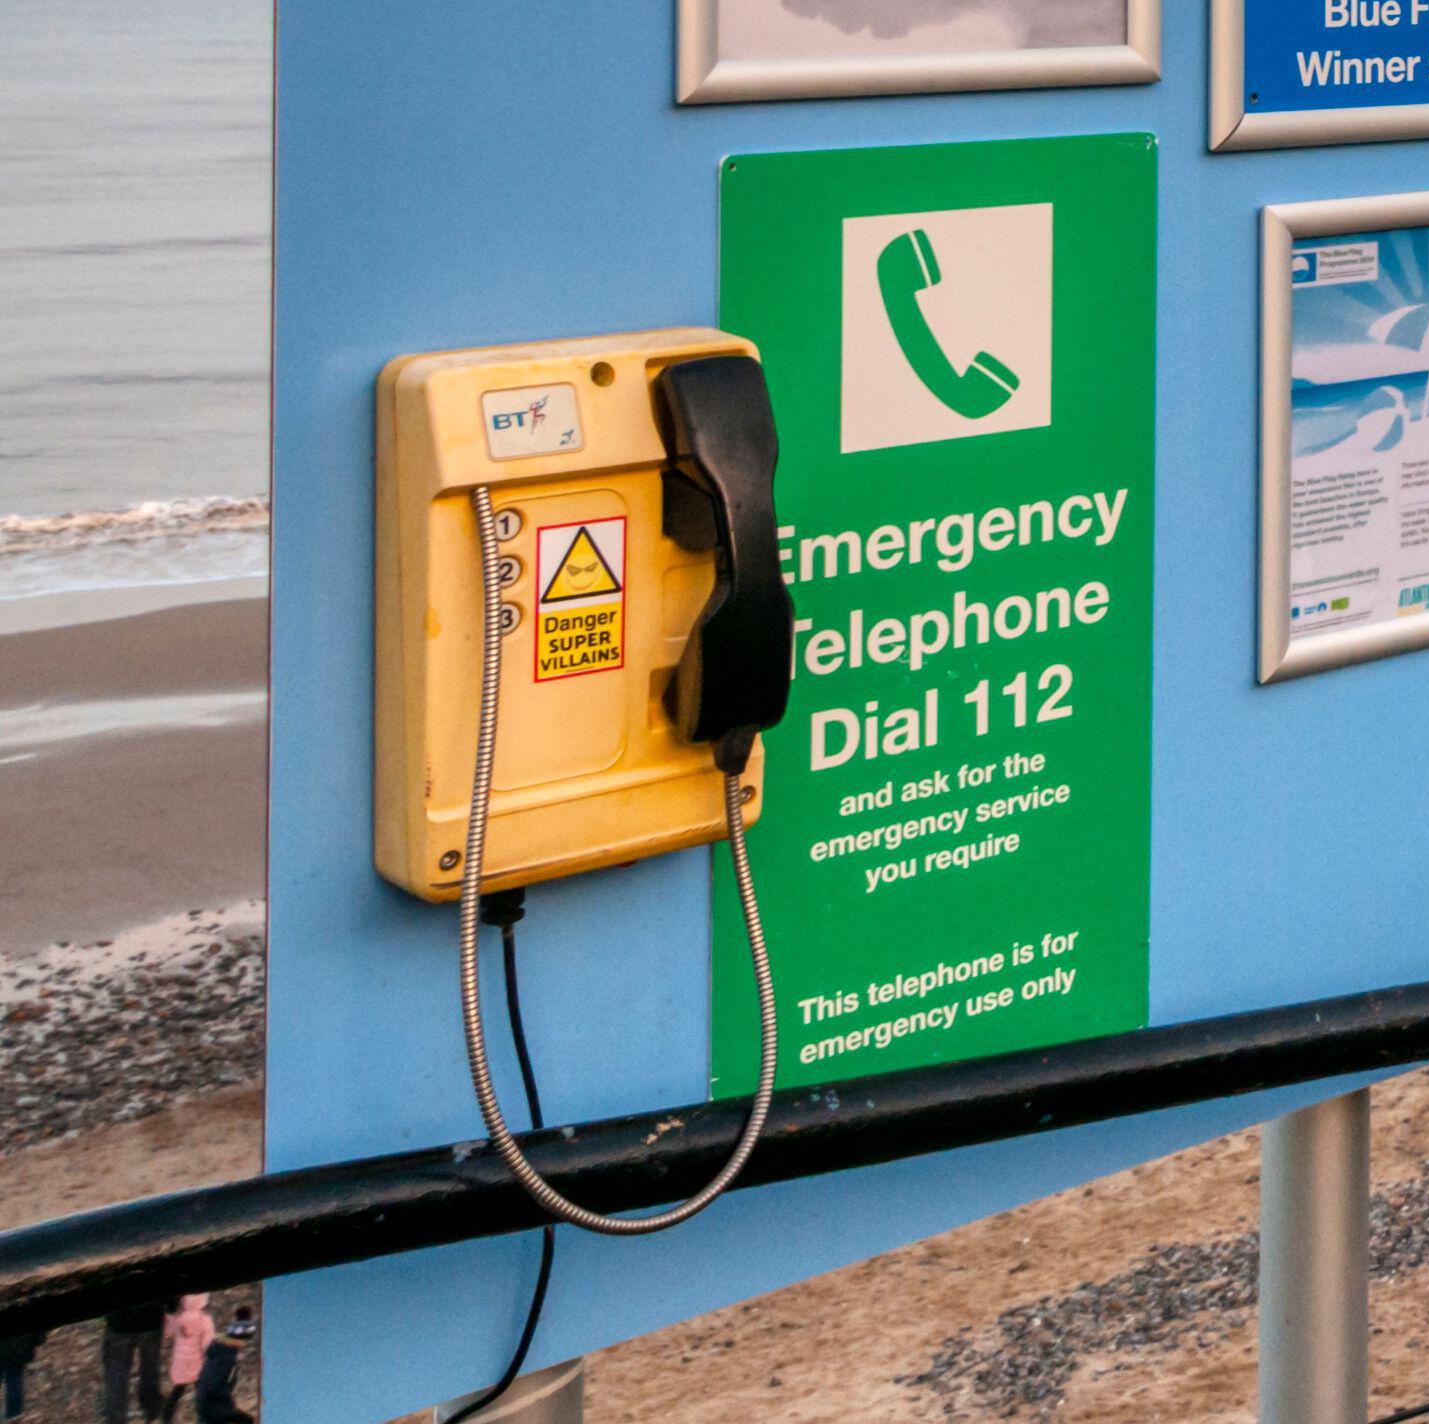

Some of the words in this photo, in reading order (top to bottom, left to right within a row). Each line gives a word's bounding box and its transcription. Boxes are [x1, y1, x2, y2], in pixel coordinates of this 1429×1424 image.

[1296, 51, 1421, 87] Winner
[492, 411, 529, 430] BT
[499, 515, 509, 536] 1
[499, 562, 513, 582] 2
[499, 608, 513, 628] 3
[544, 610, 617, 634] Danger
[549, 631, 611, 653] SUPER
[540, 647, 620, 671] VILLAINS
[810, 688, 938, 772] Dial
[964, 664, 1074, 736] 112
[839, 782, 893, 816] and
[901, 770, 949, 804] ask
[957, 760, 996, 790] for
[1003, 751, 1045, 778] the
[810, 806, 968, 862] emergency
[975, 782, 1071, 823] service
[865, 857, 917, 893] you
[924, 831, 1020, 872] require
[797, 991, 860, 1025] This
[867, 951, 1004, 1006] telephone
[1012, 943, 1034, 966] is
[1041, 930, 1079, 957] for
[799, 1001, 959, 1064] emergency
[966, 986, 1014, 1016] use
[1021, 967, 1077, 1001] only
